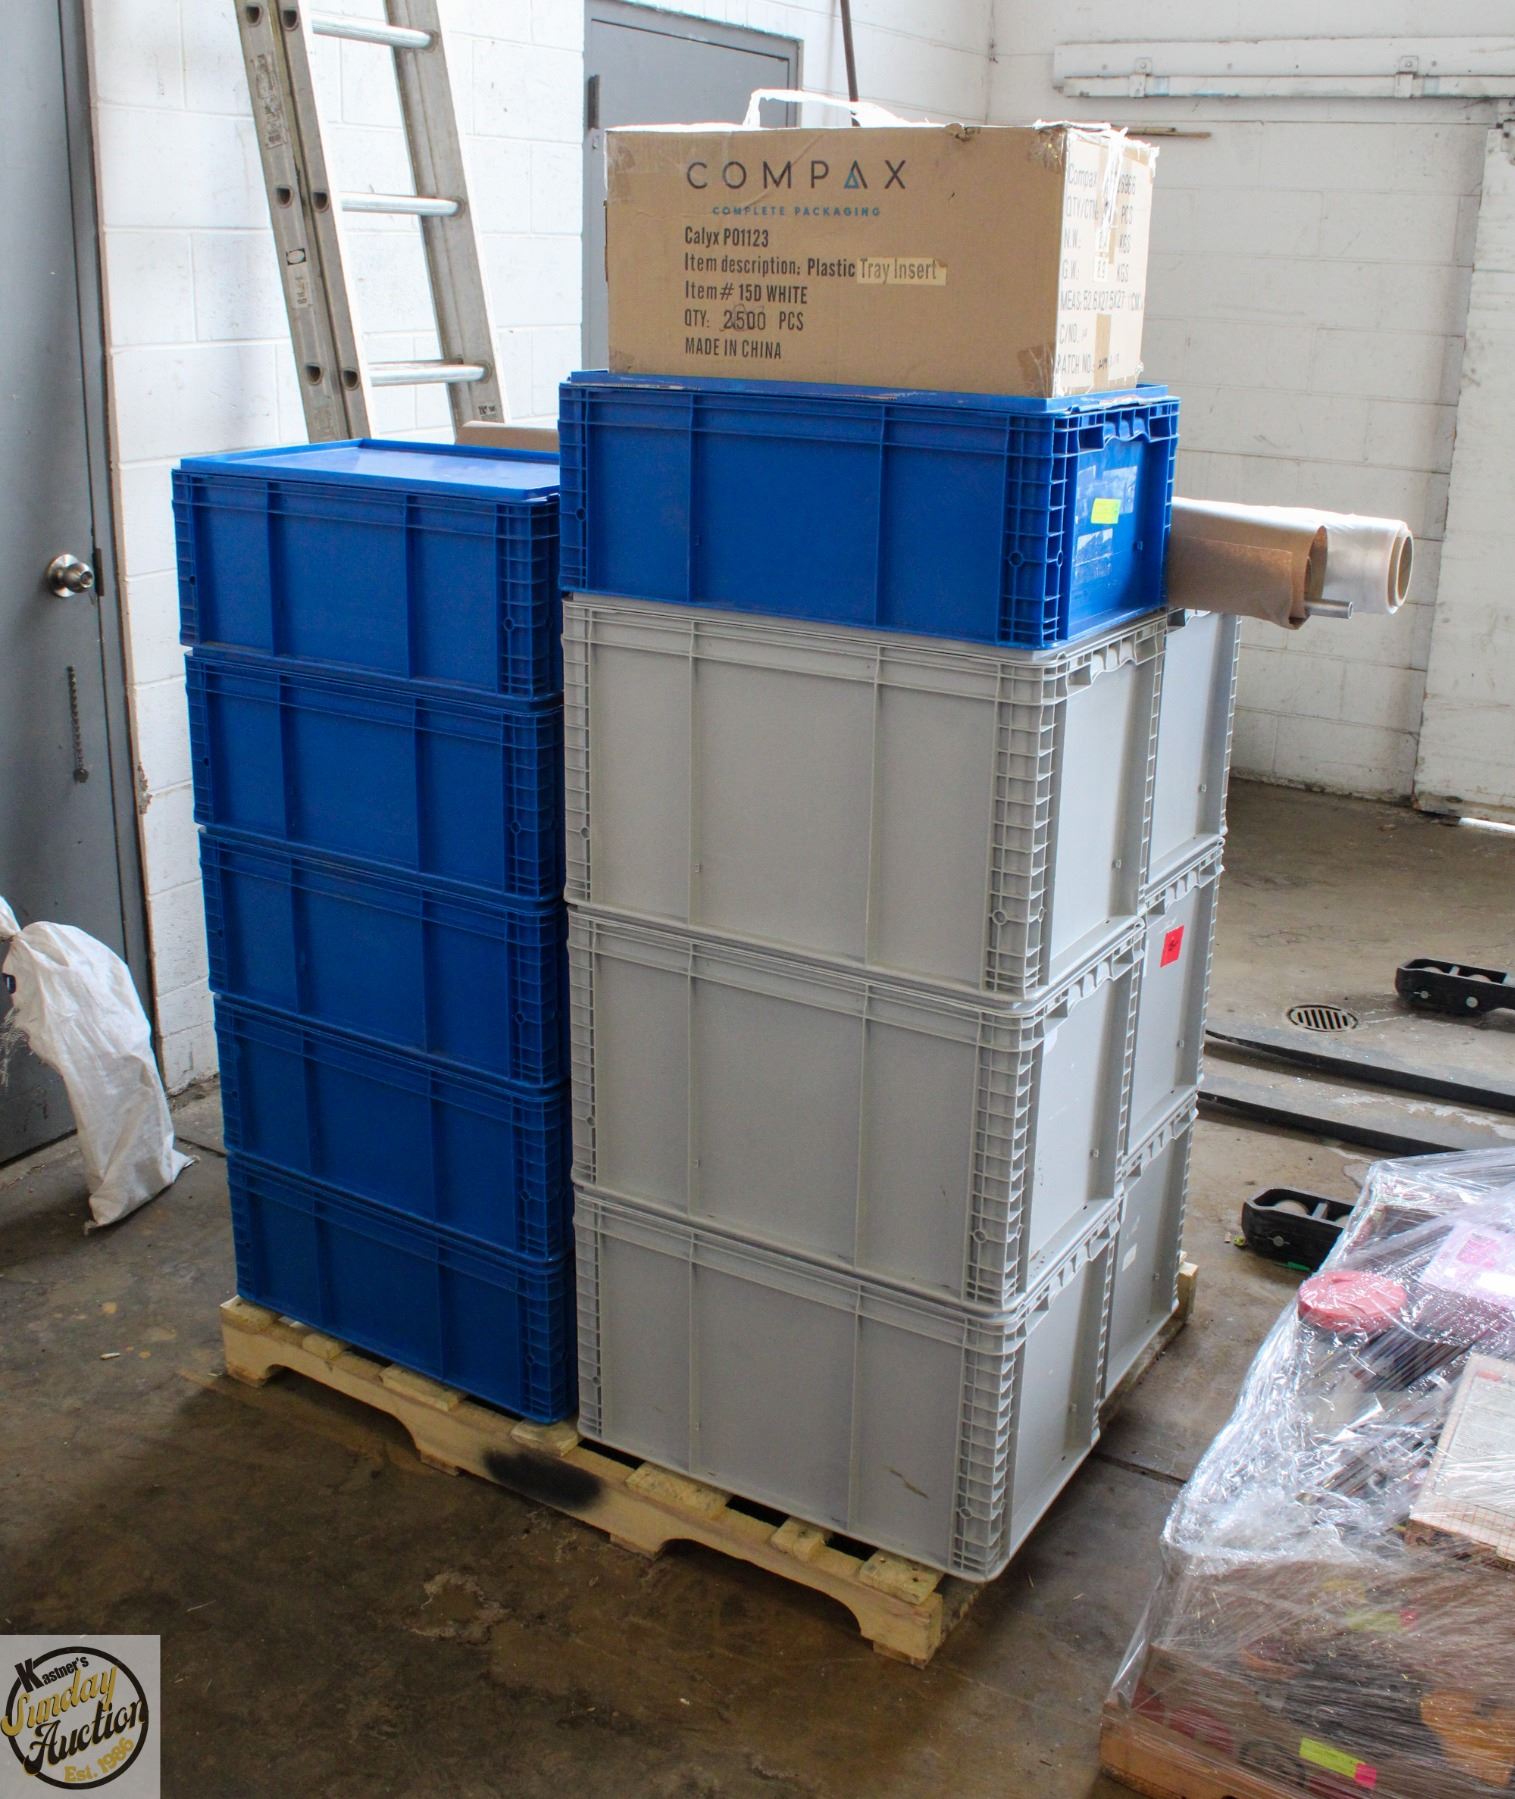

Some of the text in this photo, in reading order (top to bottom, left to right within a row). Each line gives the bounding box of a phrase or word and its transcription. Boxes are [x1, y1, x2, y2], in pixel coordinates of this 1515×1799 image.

[686, 160, 906, 189] COMPAX
[712, 207, 881, 217] COMPLETE PACKAGING
[684, 226, 719, 248] Calyx
[684, 252, 936, 285] Item description: Plastic Tray Insert
[766, 284, 808, 304] WHITE
[684, 308, 710, 329] QTY:
[779, 310, 804, 331] PCS
[685, 336, 782, 359] MADE IN CHINA
